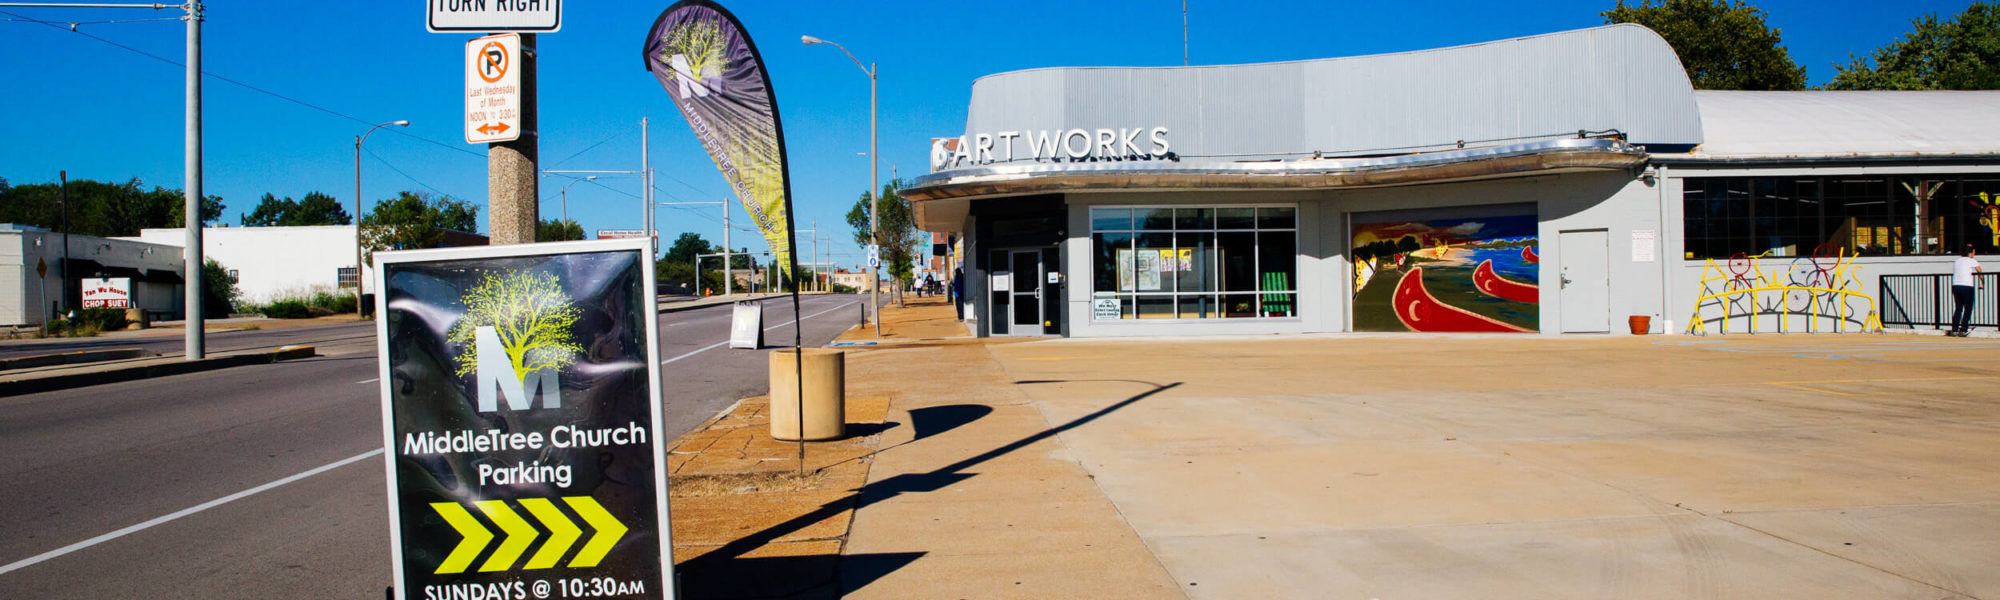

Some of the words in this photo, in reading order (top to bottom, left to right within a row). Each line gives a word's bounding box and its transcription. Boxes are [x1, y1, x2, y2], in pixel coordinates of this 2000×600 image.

[469, 87, 482, 98] Last
[484, 84, 516, 96] Wednesday
[480, 98, 487, 108] of
[488, 97, 506, 108] Month
[469, 111, 487, 122] NOON
[683, 102, 737, 177] MIDDLETREE
[736, 181, 775, 233] CHURCH
[109, 287, 127, 296] House
[84, 299, 105, 308] CHOP
[107, 299, 127, 308] SUEY
[403, 429, 544, 456] MiddleTree
[550, 421, 647, 448] Church
[478, 461, 572, 489] Parking
[424, 581, 526, 600] SUNDAYS
[532, 579, 551, 599] @
